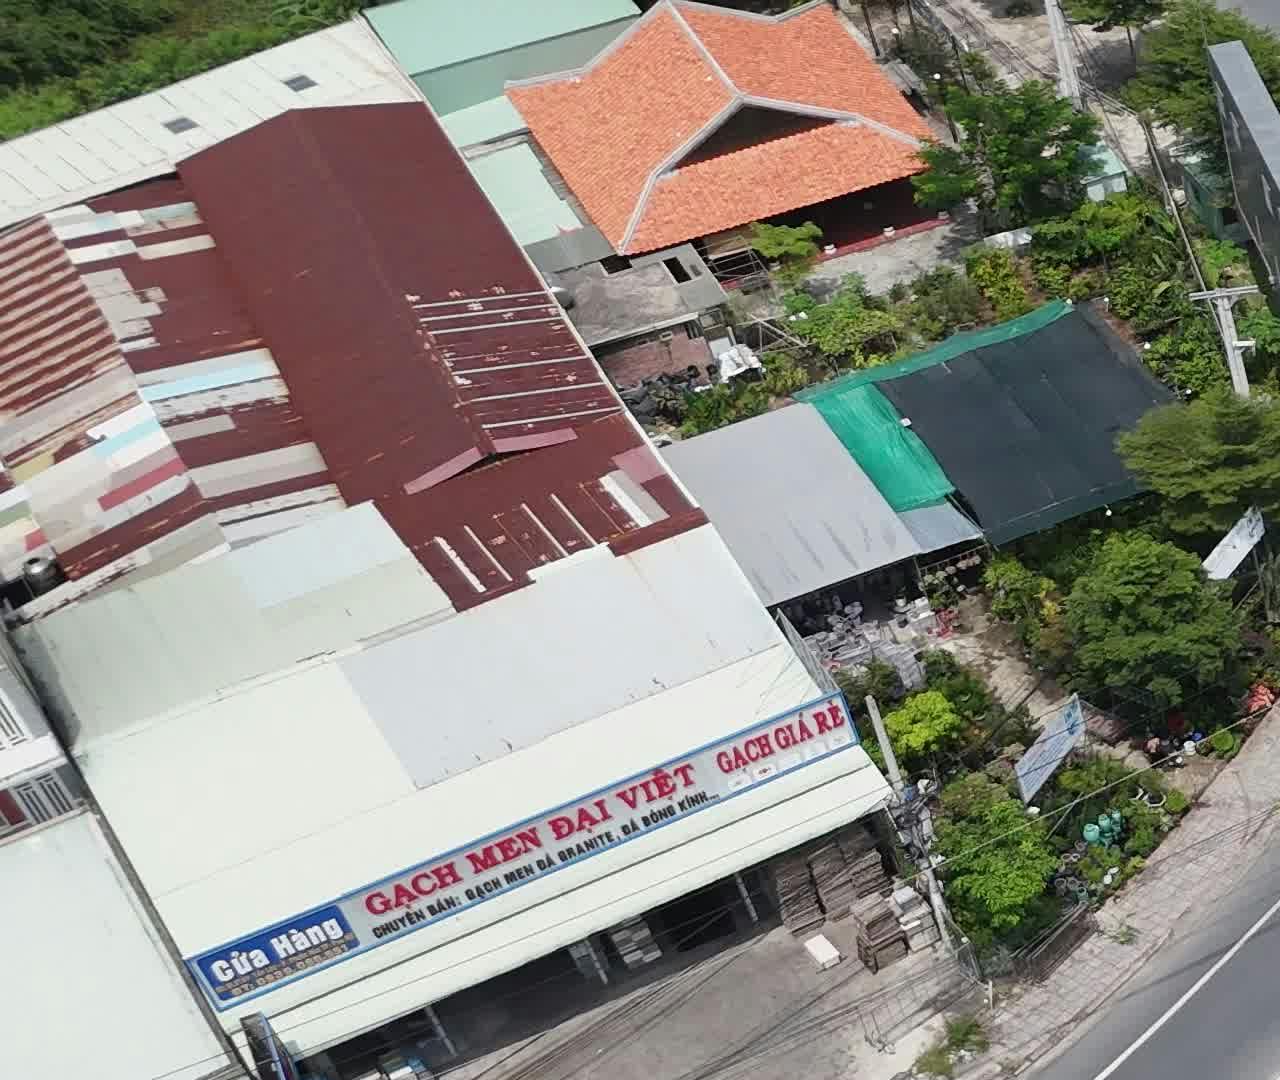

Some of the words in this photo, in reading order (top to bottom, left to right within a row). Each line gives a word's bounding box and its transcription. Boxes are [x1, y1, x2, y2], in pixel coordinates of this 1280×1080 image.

[717, 734, 775, 774] GẠCH
[774, 712, 814, 750] GIÁ
[813, 699, 845, 734] RẺ
[365, 861, 463, 915] GẠCH
[466, 827, 542, 875] MEN
[547, 799, 613, 841] ĐẠI
[616, 763, 695, 810] VIỆT
[503, 864, 535, 884] MEN
[210, 949, 270, 982] Cửa
[271, 918, 344, 958] Hàng
